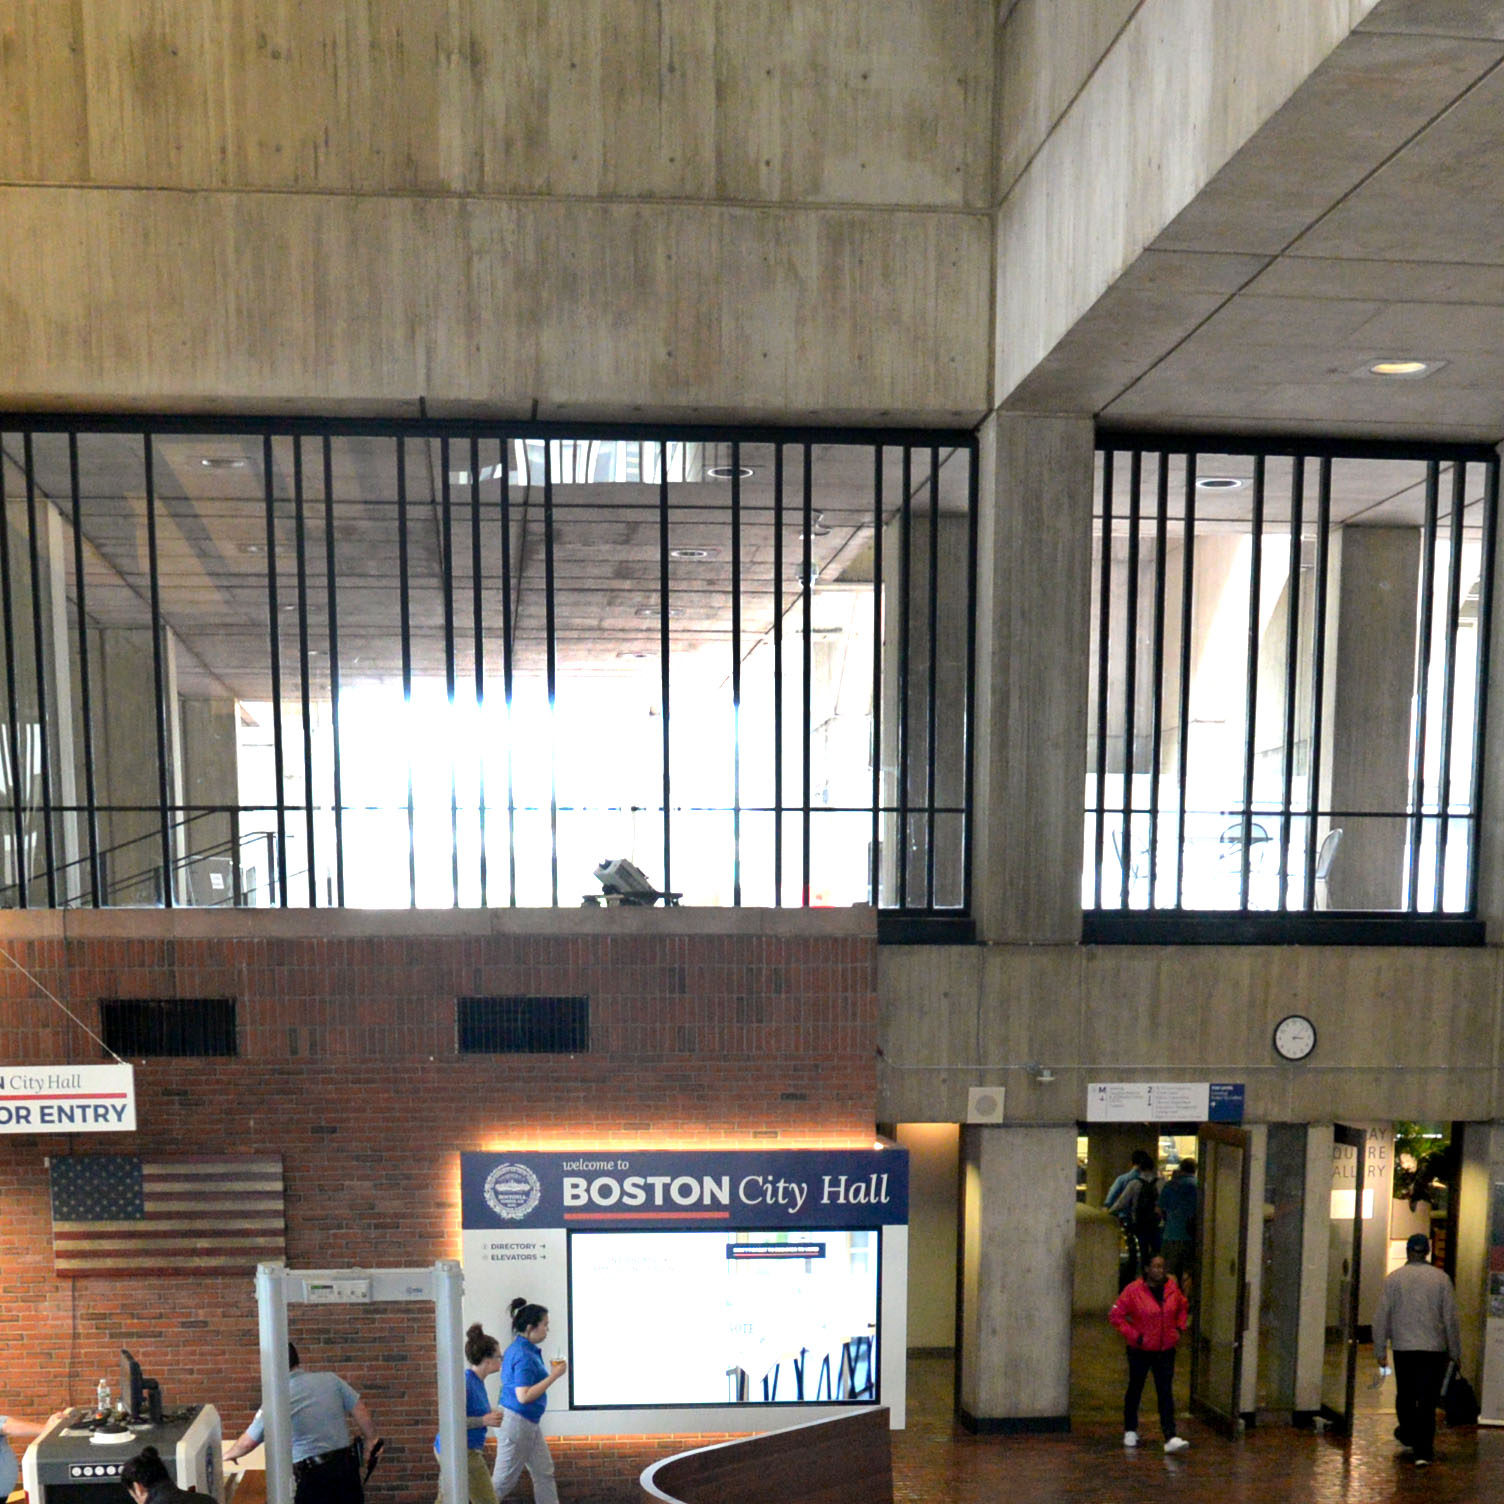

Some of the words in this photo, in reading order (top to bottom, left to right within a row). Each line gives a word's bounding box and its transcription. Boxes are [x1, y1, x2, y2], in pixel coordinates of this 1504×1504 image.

[9, 1074, 43, 1094] City
[47, 1073, 82, 1091] Hall
[39, 1102, 128, 1125] ENTRY
[563, 1159, 614, 1171] welcome
[617, 1160, 629, 1171] to
[563, 1175, 730, 1206] BOSTON
[738, 1174, 807, 1213] City
[821, 1173, 890, 1205] Hall
